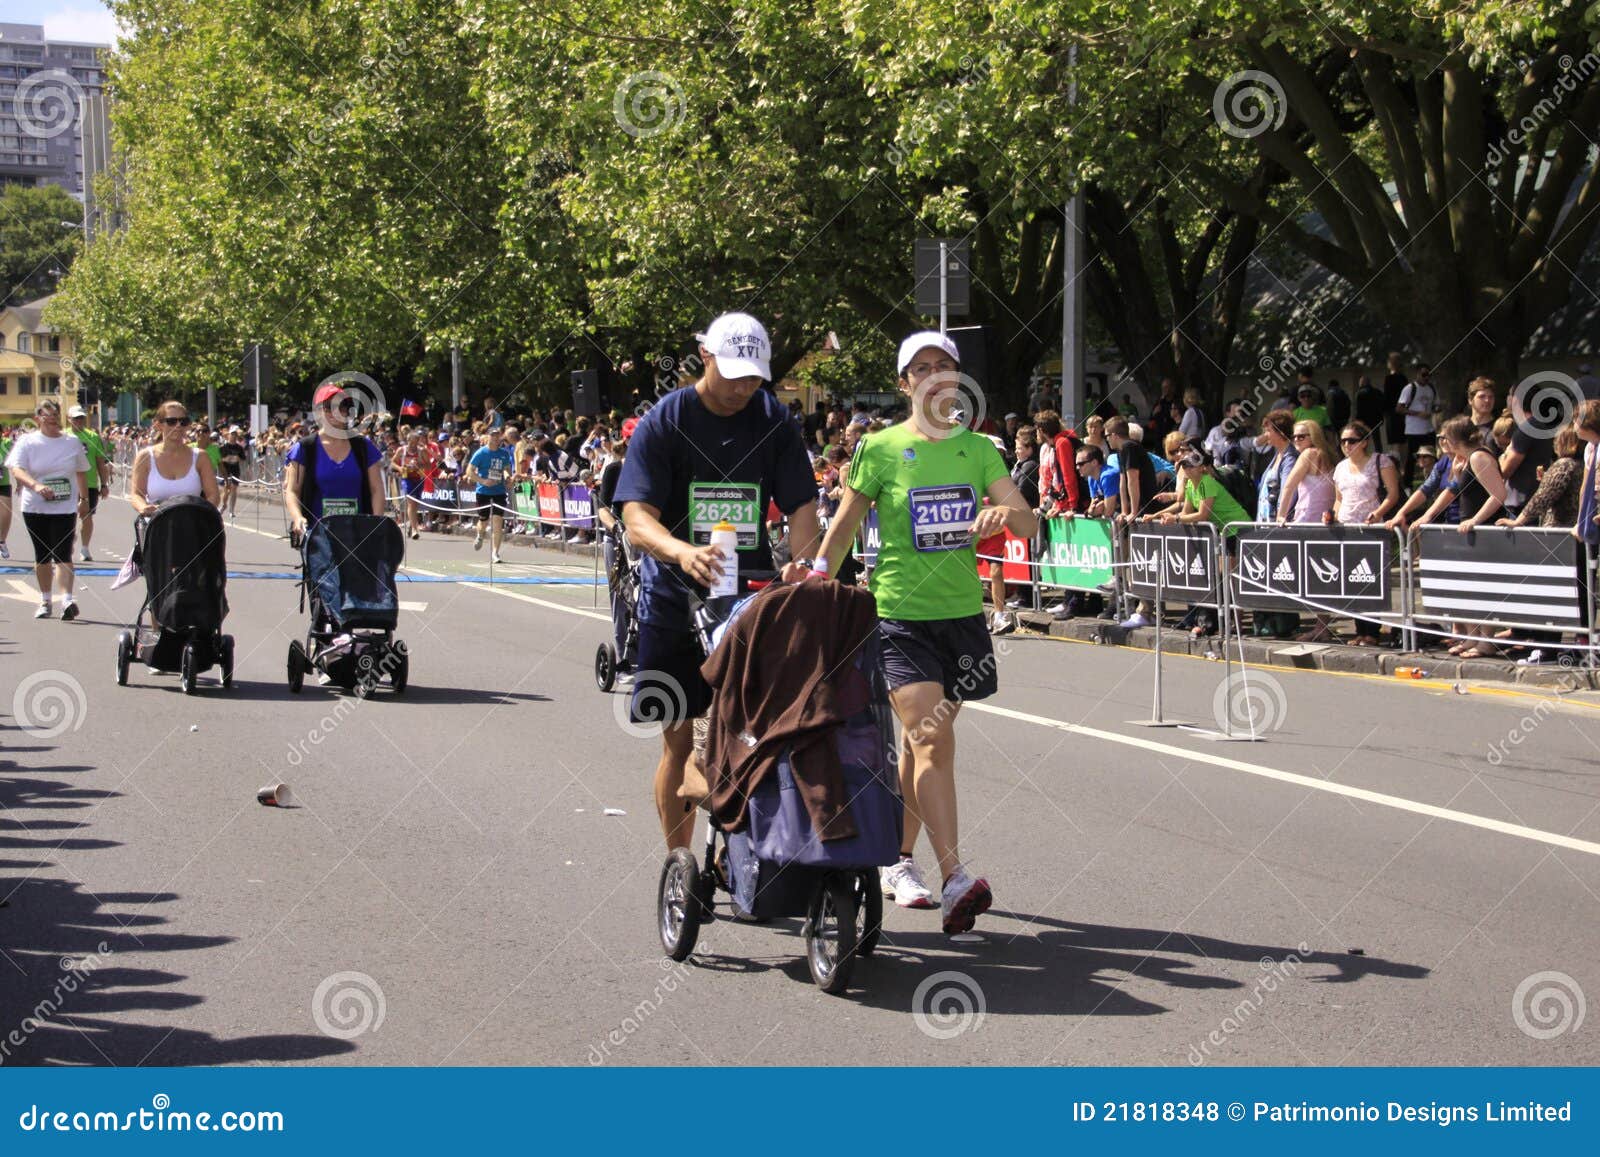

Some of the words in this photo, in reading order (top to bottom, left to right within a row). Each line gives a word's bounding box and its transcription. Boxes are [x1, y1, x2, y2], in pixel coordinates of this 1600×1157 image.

[737, 345, 759, 359] XVI
[716, 490, 743, 499] adidas
[934, 491, 961, 501] adidas
[695, 502, 754, 522] 26231
[916, 501, 974, 524] 21677
[1272, 572, 1295, 581] adidas
[1347, 573, 1377, 583] adidas
